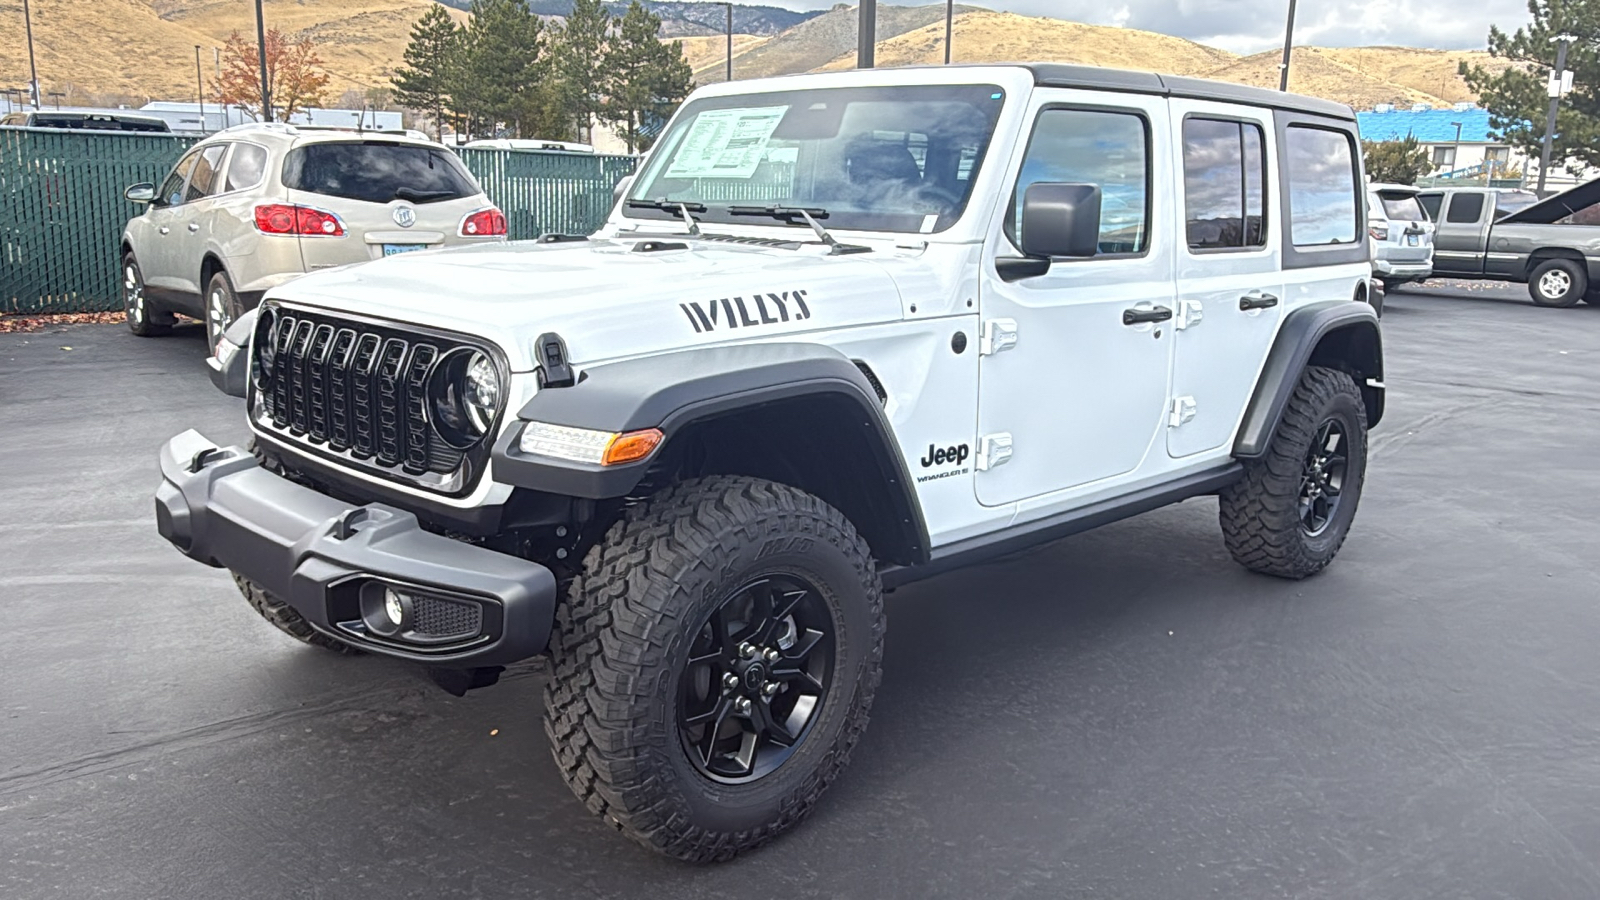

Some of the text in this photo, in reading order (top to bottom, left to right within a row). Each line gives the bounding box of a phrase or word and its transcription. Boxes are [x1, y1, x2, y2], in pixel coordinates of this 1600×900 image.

[679, 290, 810, 333] WILLYS
[920, 443, 969, 468] Jeep
[917, 469, 961, 483] WRANGLER
